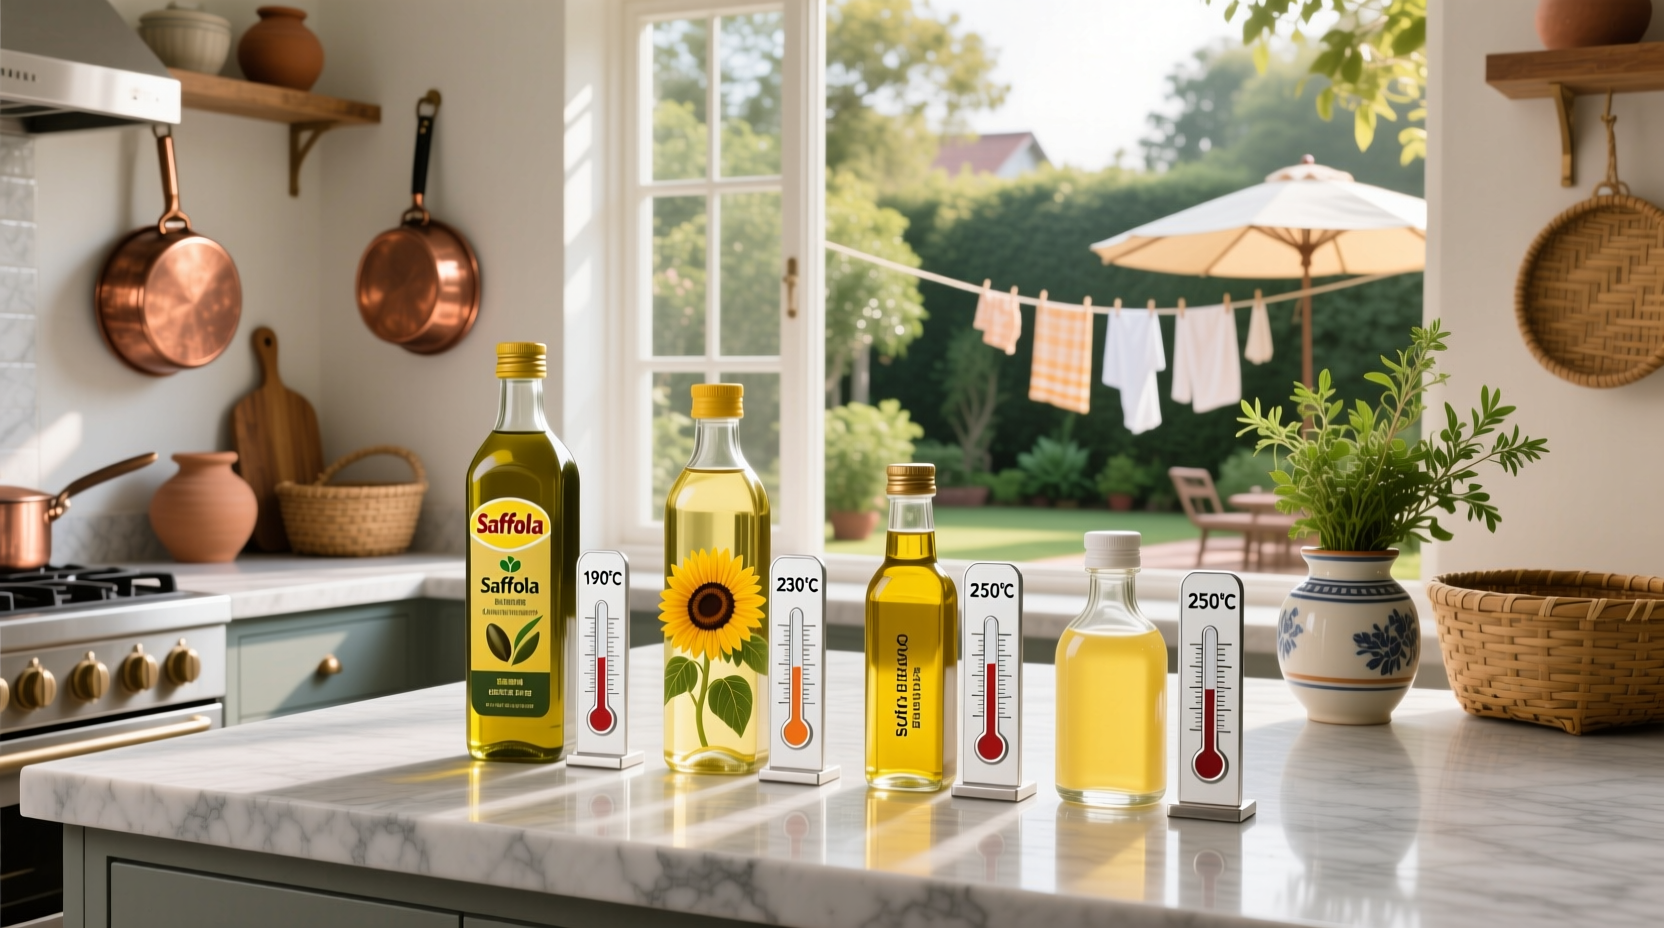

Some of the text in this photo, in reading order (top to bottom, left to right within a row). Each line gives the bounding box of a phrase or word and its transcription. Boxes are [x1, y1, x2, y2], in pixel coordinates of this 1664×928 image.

[477, 512, 543, 535] Saffola
[480, 576, 539, 594] Saffola
[970, 582, 1015, 599] 250°C
